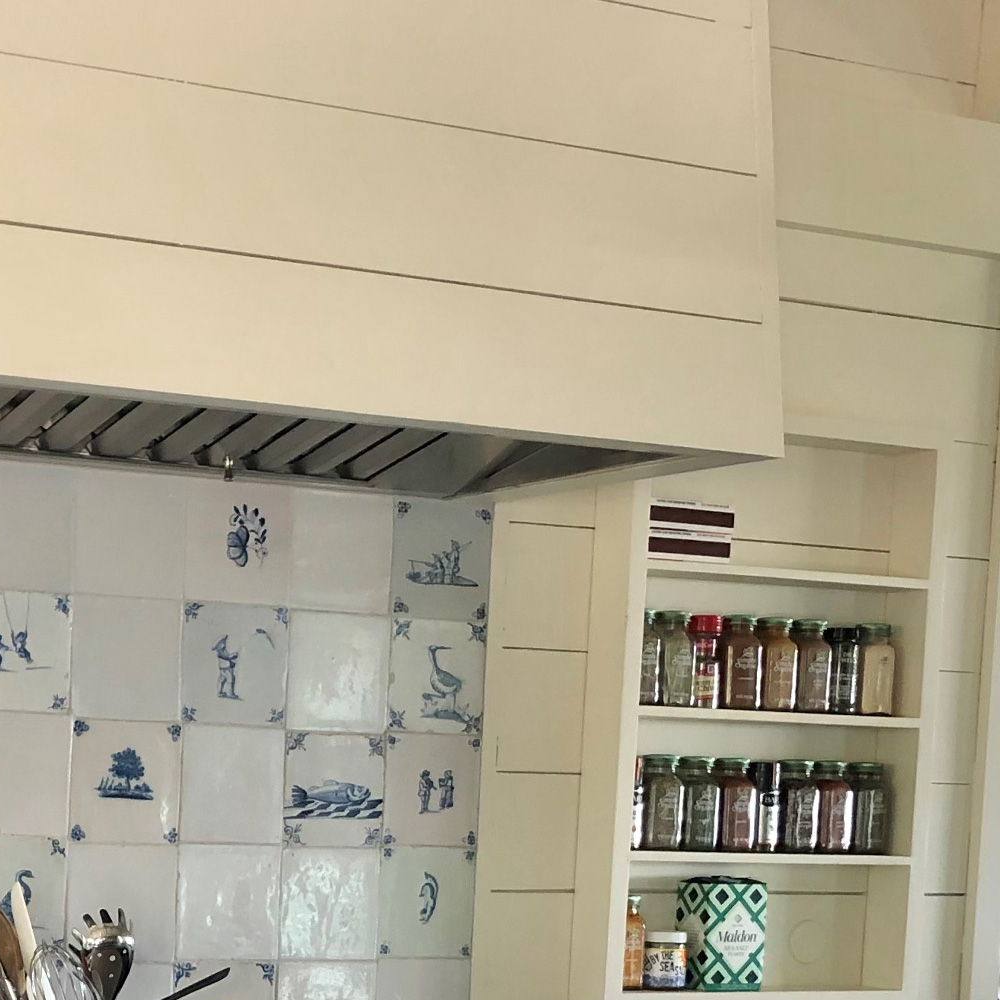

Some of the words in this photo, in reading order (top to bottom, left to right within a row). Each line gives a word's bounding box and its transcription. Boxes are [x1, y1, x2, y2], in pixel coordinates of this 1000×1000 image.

[716, 929, 757, 943] Maldon
[650, 953, 660, 965] BY
[661, 950, 674, 960] THE
[659, 961, 675, 972] SEA
